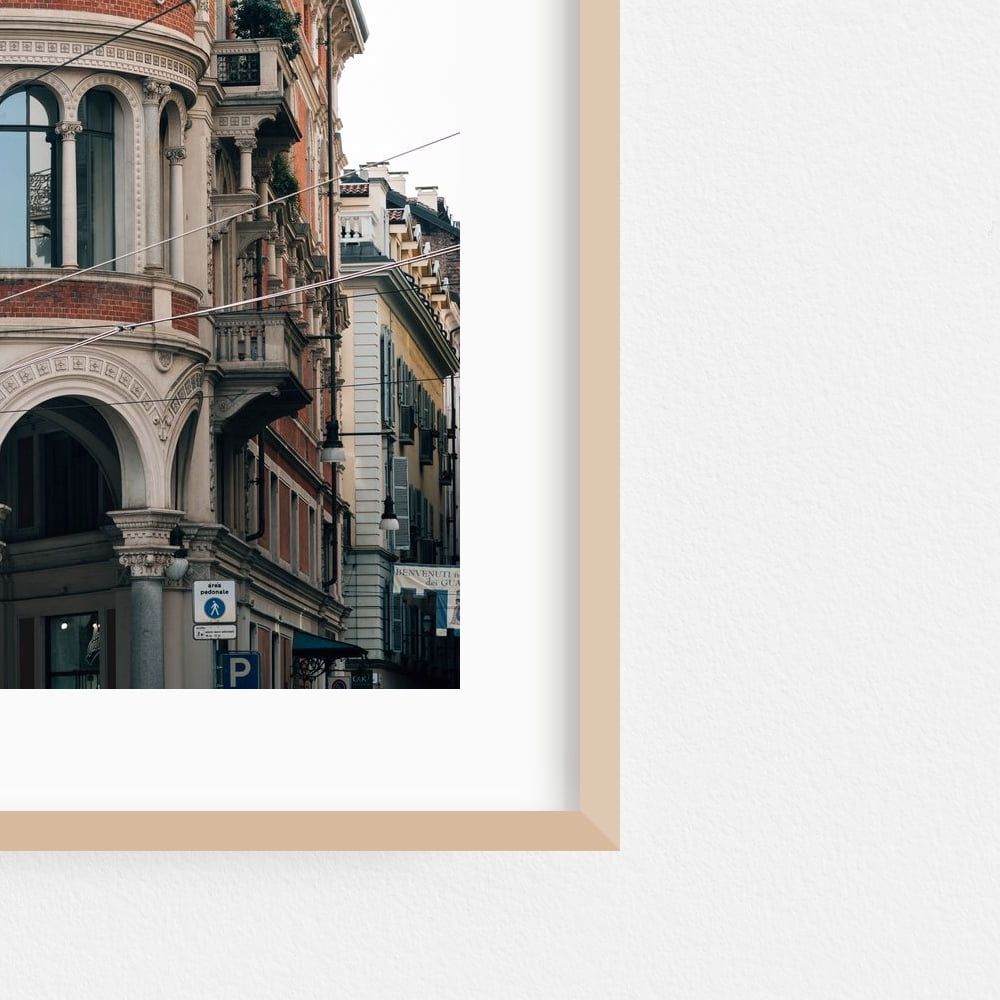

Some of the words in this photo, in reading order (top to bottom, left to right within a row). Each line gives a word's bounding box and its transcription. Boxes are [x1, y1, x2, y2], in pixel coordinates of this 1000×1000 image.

[396, 568, 451, 577] BENVENUTI
[426, 577, 438, 586] dei
[230, 657, 251, 687] P
